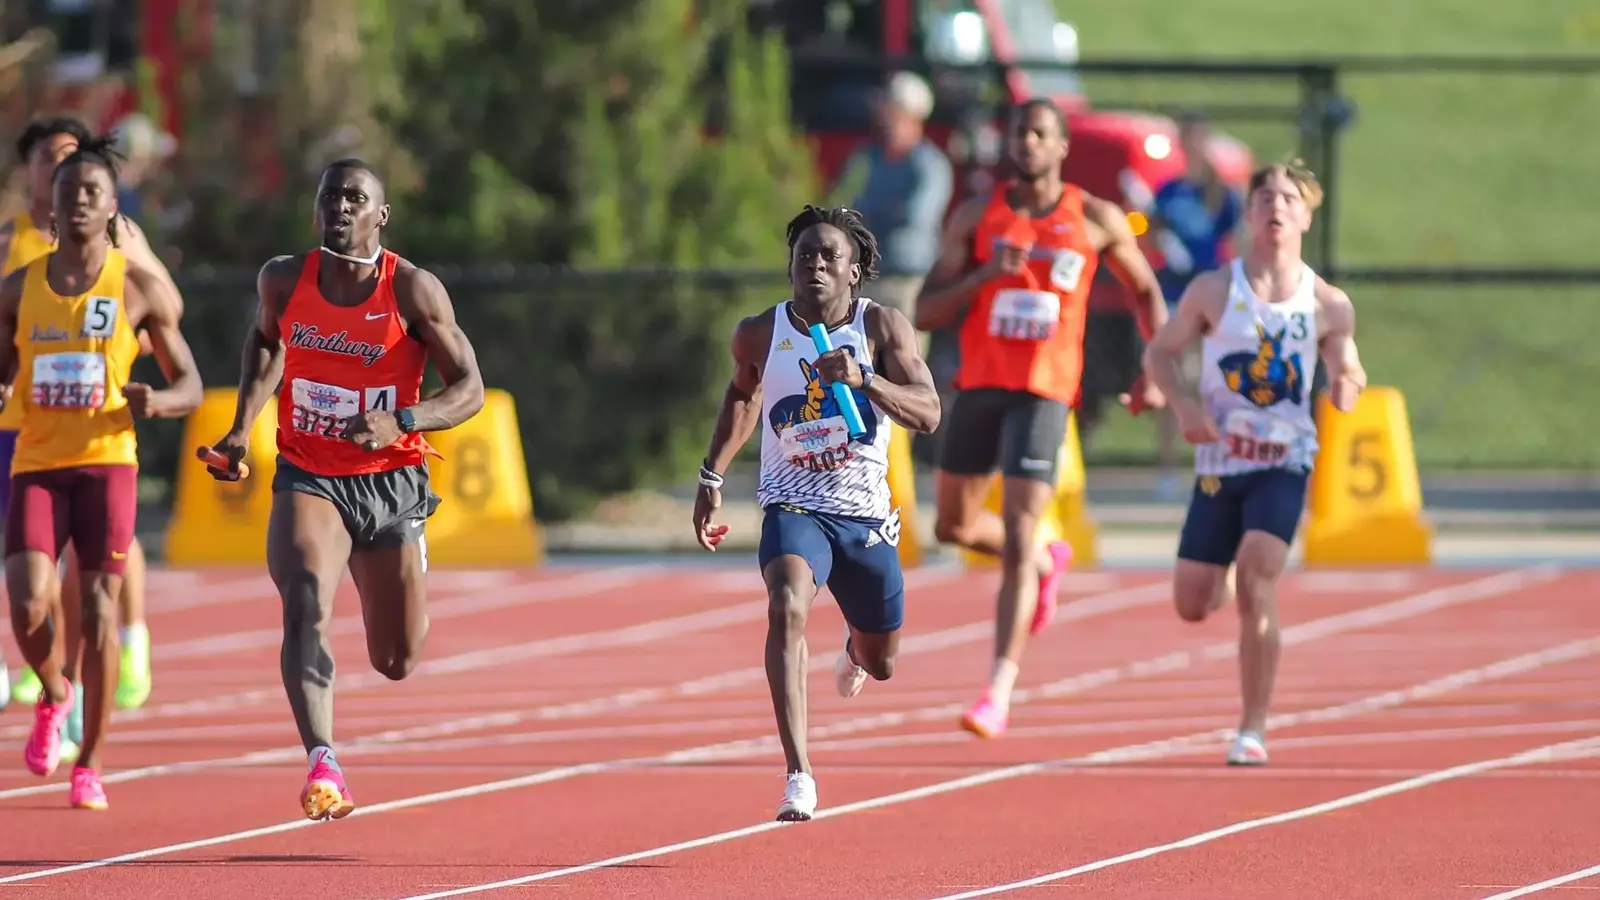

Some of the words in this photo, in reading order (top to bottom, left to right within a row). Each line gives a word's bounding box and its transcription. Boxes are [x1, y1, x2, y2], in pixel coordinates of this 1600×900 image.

[92, 299, 111, 331] 5
[1291, 311, 1307, 341] 3
[288, 321, 387, 367] Wartburg
[367, 389, 388, 412] 4
[454, 438, 493, 507] 8
[1347, 432, 1386, 503] 5
